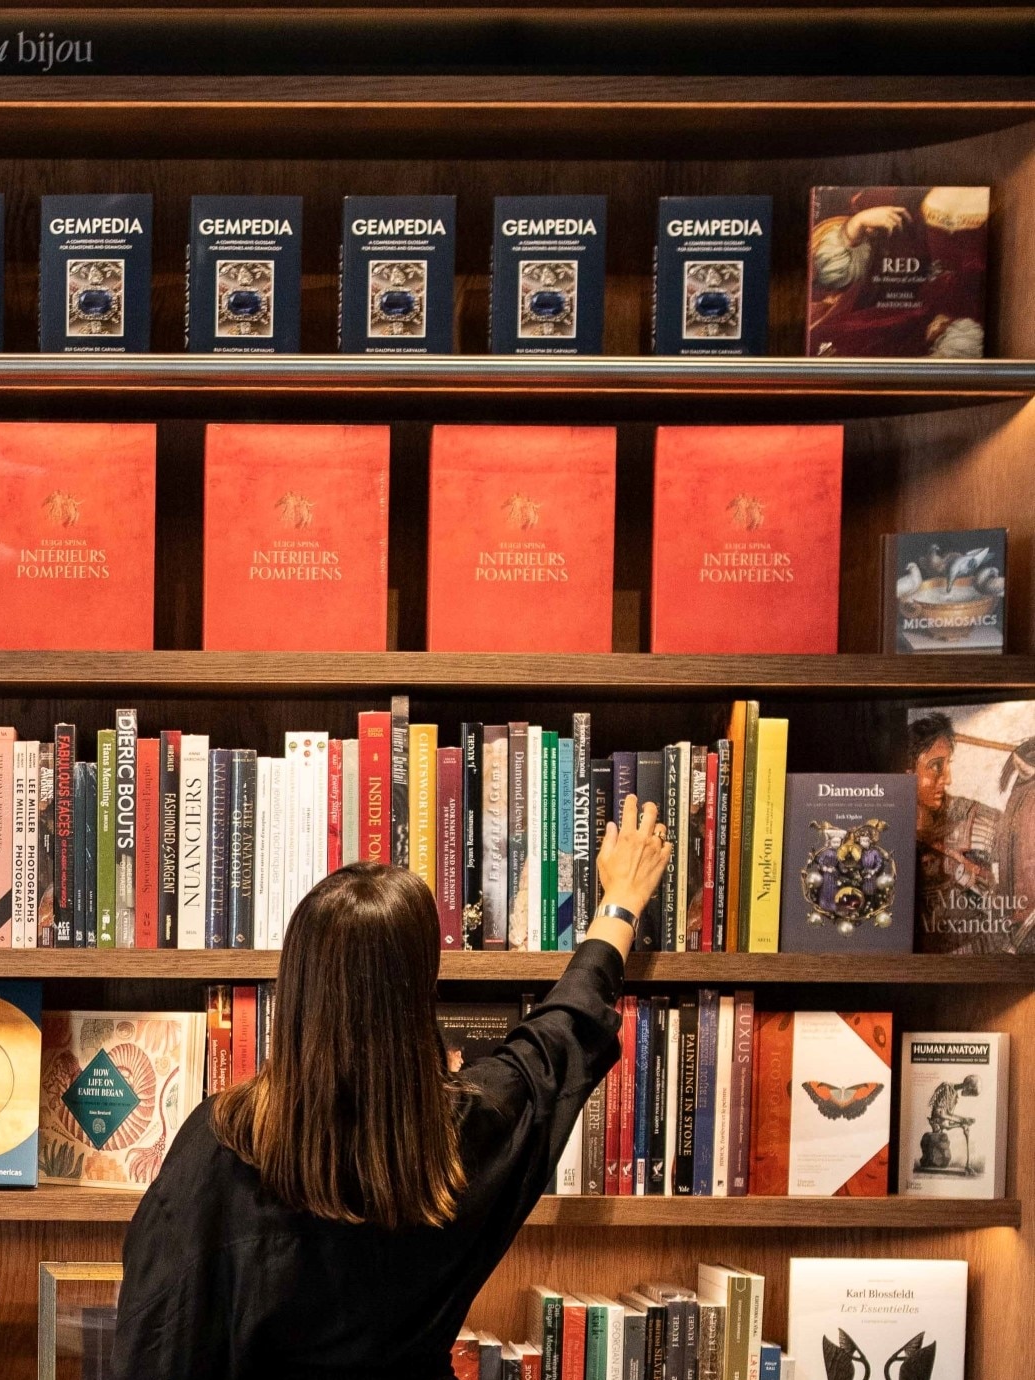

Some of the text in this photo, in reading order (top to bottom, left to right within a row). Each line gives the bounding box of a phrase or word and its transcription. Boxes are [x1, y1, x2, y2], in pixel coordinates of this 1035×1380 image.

[17, 31, 93, 71] bijou
[50, 218, 142, 234] GEMPEDIA
[199, 219, 292, 235] GEMPEDIA
[352, 219, 445, 235] GEMPEDIA
[502, 219, 596, 235] GEMPEDIA
[668, 220, 762, 236] GEMPEDIA
[882, 257, 920, 273] RED
[20, 545, 106, 563] INTÉRIEURS
[252, 547, 339, 565] INTÉRIEURS
[479, 548, 565, 566] INTÉRIEURS
[703, 549, 791, 567] INTÉRIEURS
[16, 560, 109, 579] POMPÉIENS
[249, 562, 342, 581] POMPÉIENS
[475, 563, 568, 582] POMPÉIENS
[700, 563, 794, 583] POMPÉIENS
[903, 615, 997, 629] MICROMOSAICS
[100, 743, 112, 807] Hans Memling
[117, 716, 134, 848] DIERIC BOUTS
[668, 754, 676, 827] VAN GOGH
[818, 783, 885, 798] Diamonds
[369, 777, 382, 826] INSIDE
[573, 783, 590, 861] MEDUSA
[14, 778, 24, 923] LEE MILLER PHOTOGRAPHS
[27, 778, 36, 923] LEE MILLER PHOTOGRAPHS
[184, 777, 202, 908] NUANCIERS
[757, 838, 773, 901] Napoléon
[738, 1003, 752, 1064] LUXUS
[914, 1045, 988, 1056] HUMAN ANATOMY
[88, 1078, 103, 1086] LIFE
[78, 1088, 124, 1097] EARTH BEGAN
[683, 1034, 695, 1156] PAINTING IN STONE
[846, 1289, 914, 1298] Karl Blossfeldt
[840, 1304, 919, 1313] Les Essentielles
